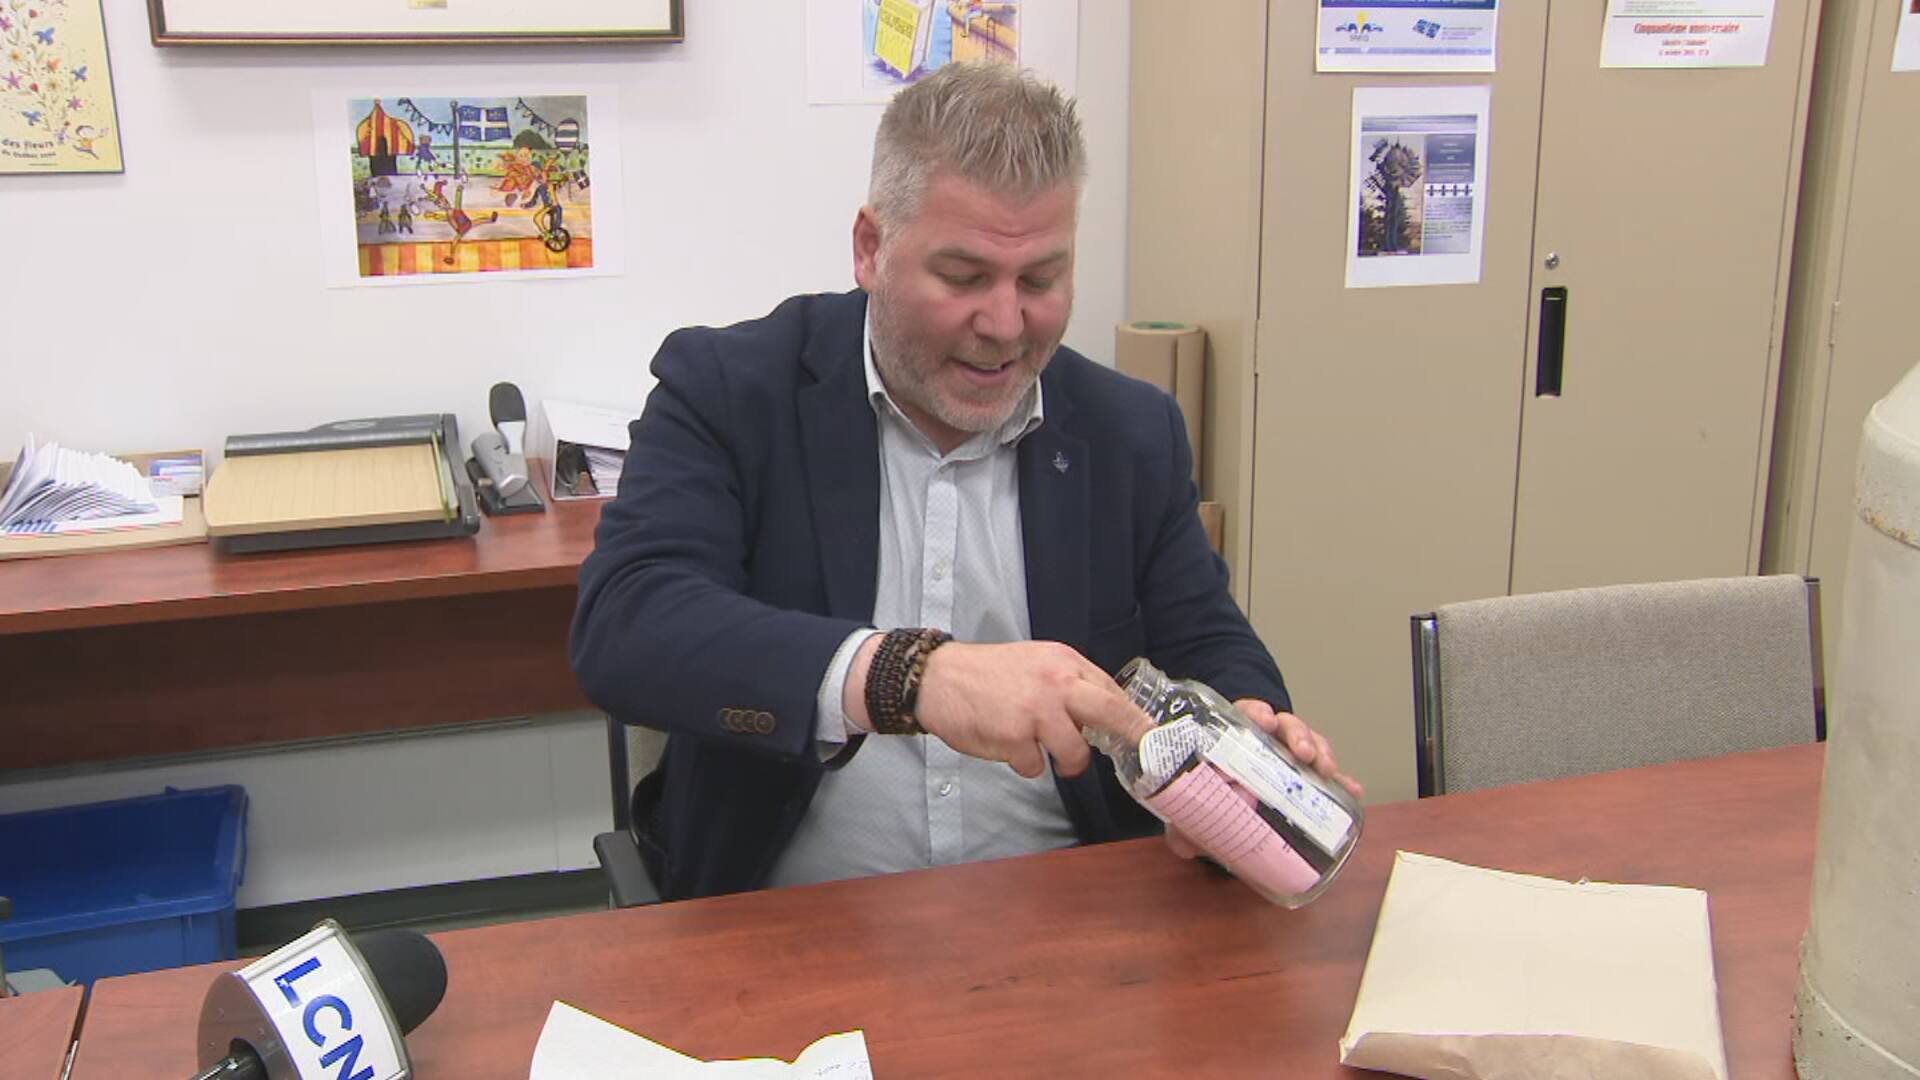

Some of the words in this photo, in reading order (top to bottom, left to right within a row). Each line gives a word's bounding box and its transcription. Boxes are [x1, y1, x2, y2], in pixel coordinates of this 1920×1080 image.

[1, 139, 21, 148] des
[24, 140, 54, 151] fleurs
[273, 956, 376, 1080] LCN
